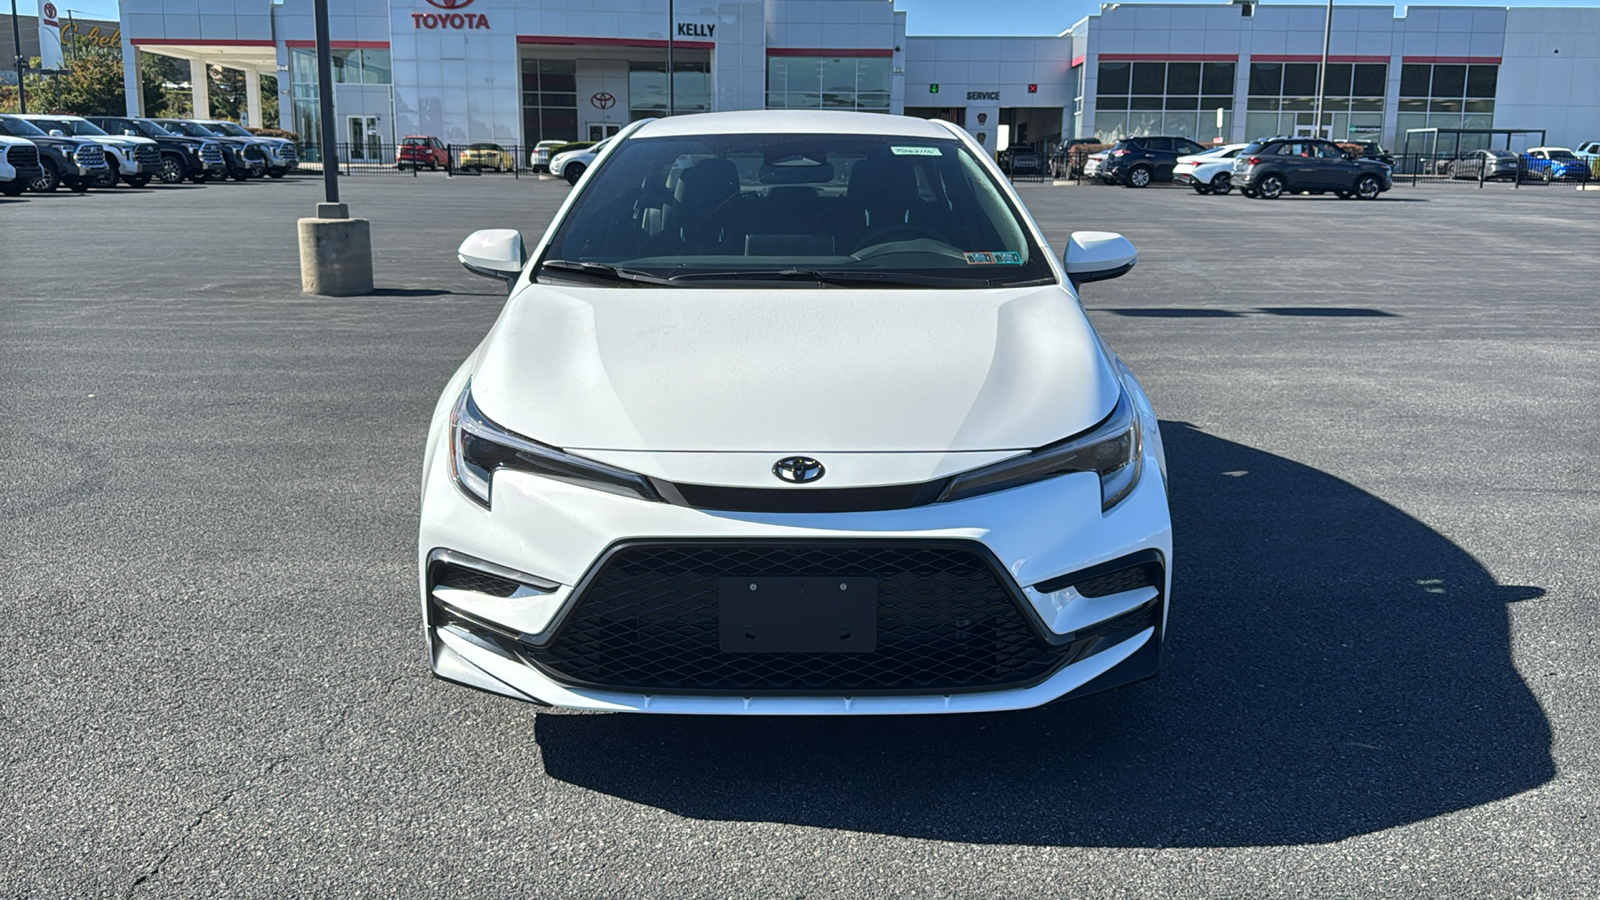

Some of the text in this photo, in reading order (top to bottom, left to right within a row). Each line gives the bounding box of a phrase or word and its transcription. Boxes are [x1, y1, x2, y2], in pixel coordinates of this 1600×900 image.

[410, 13, 491, 30] TOYOTA
[677, 22, 716, 38] KELLY
[966, 91, 1000, 101] SERVICE
